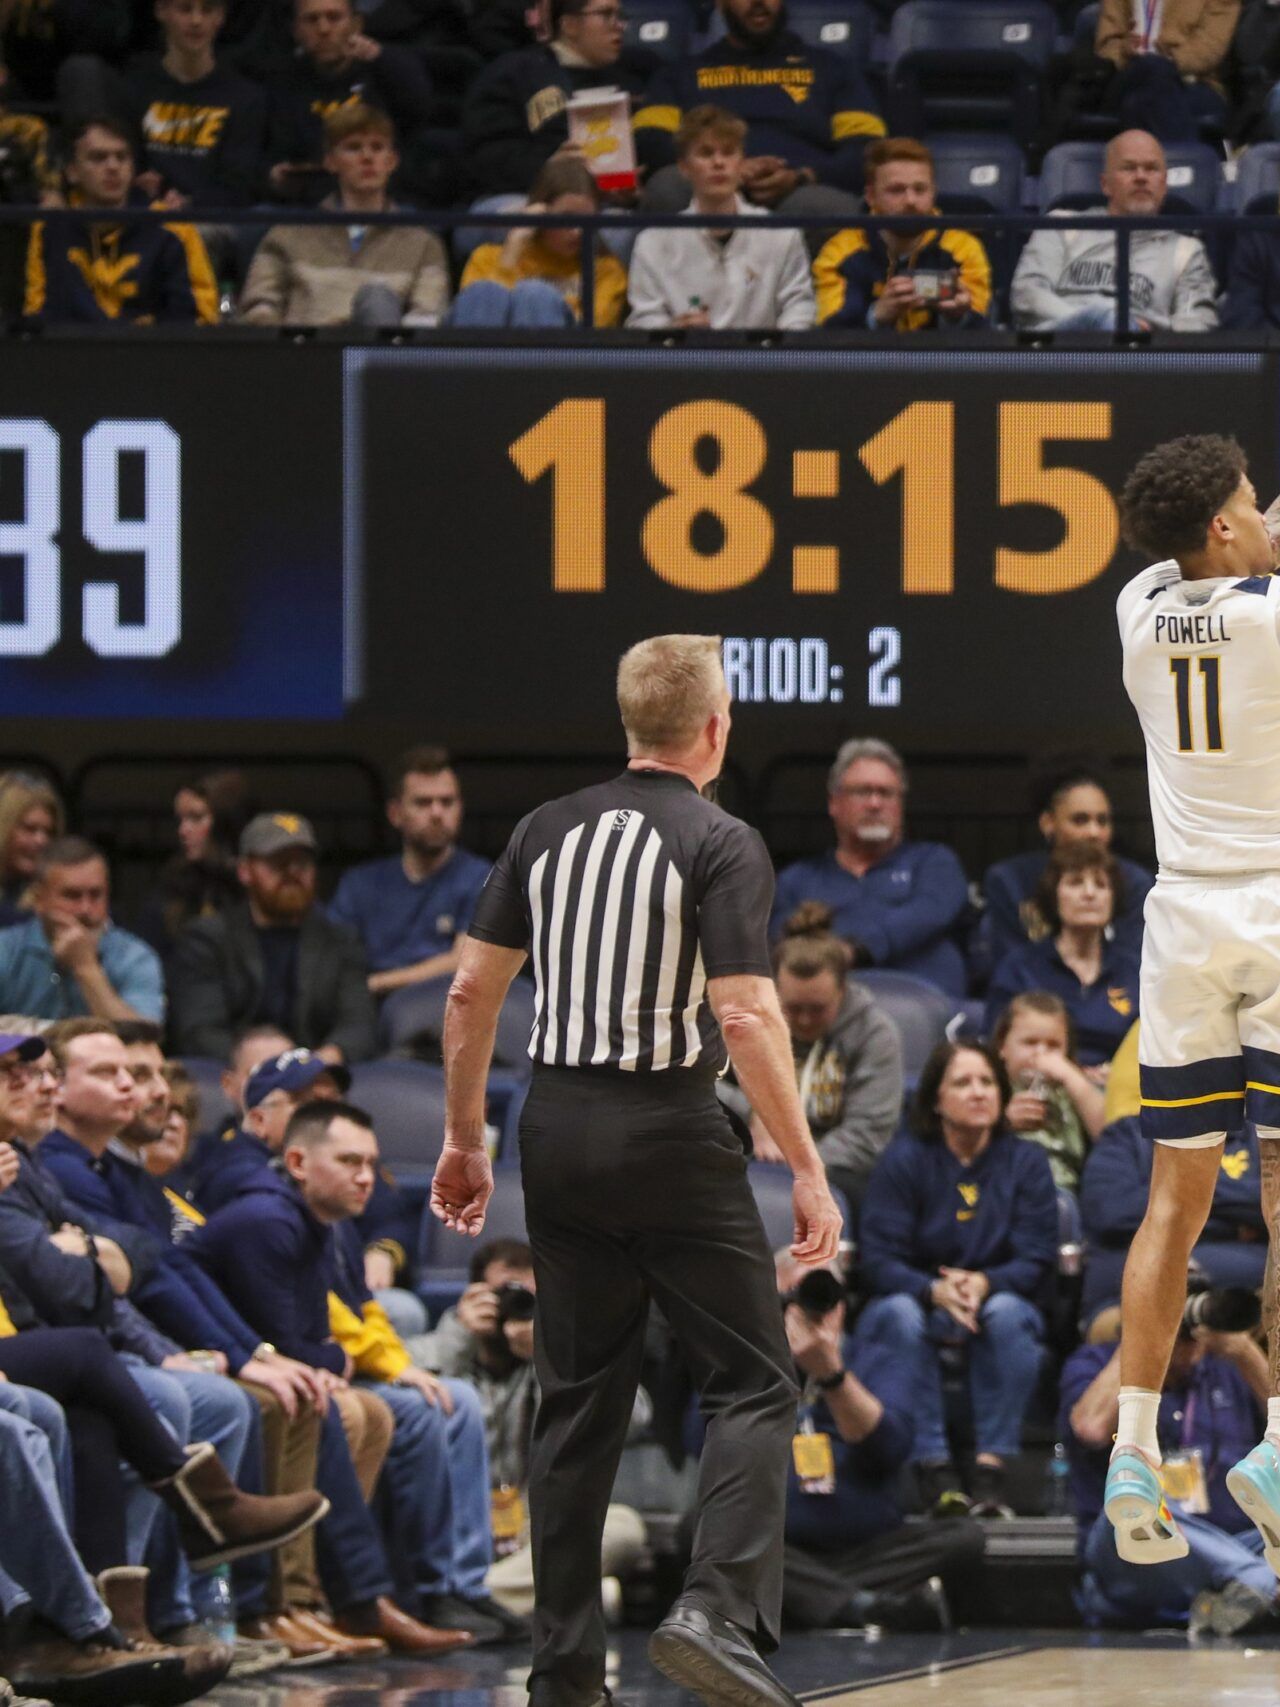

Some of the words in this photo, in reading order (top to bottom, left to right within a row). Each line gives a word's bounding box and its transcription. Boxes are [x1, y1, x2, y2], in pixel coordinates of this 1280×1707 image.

[508, 398, 1120, 595] 18:15
[722, 637, 844, 703] RIOD:
[868, 626, 901, 706] 2
[1155, 614, 1231, 644] POWELL
[1169, 655, 1225, 753] 11
